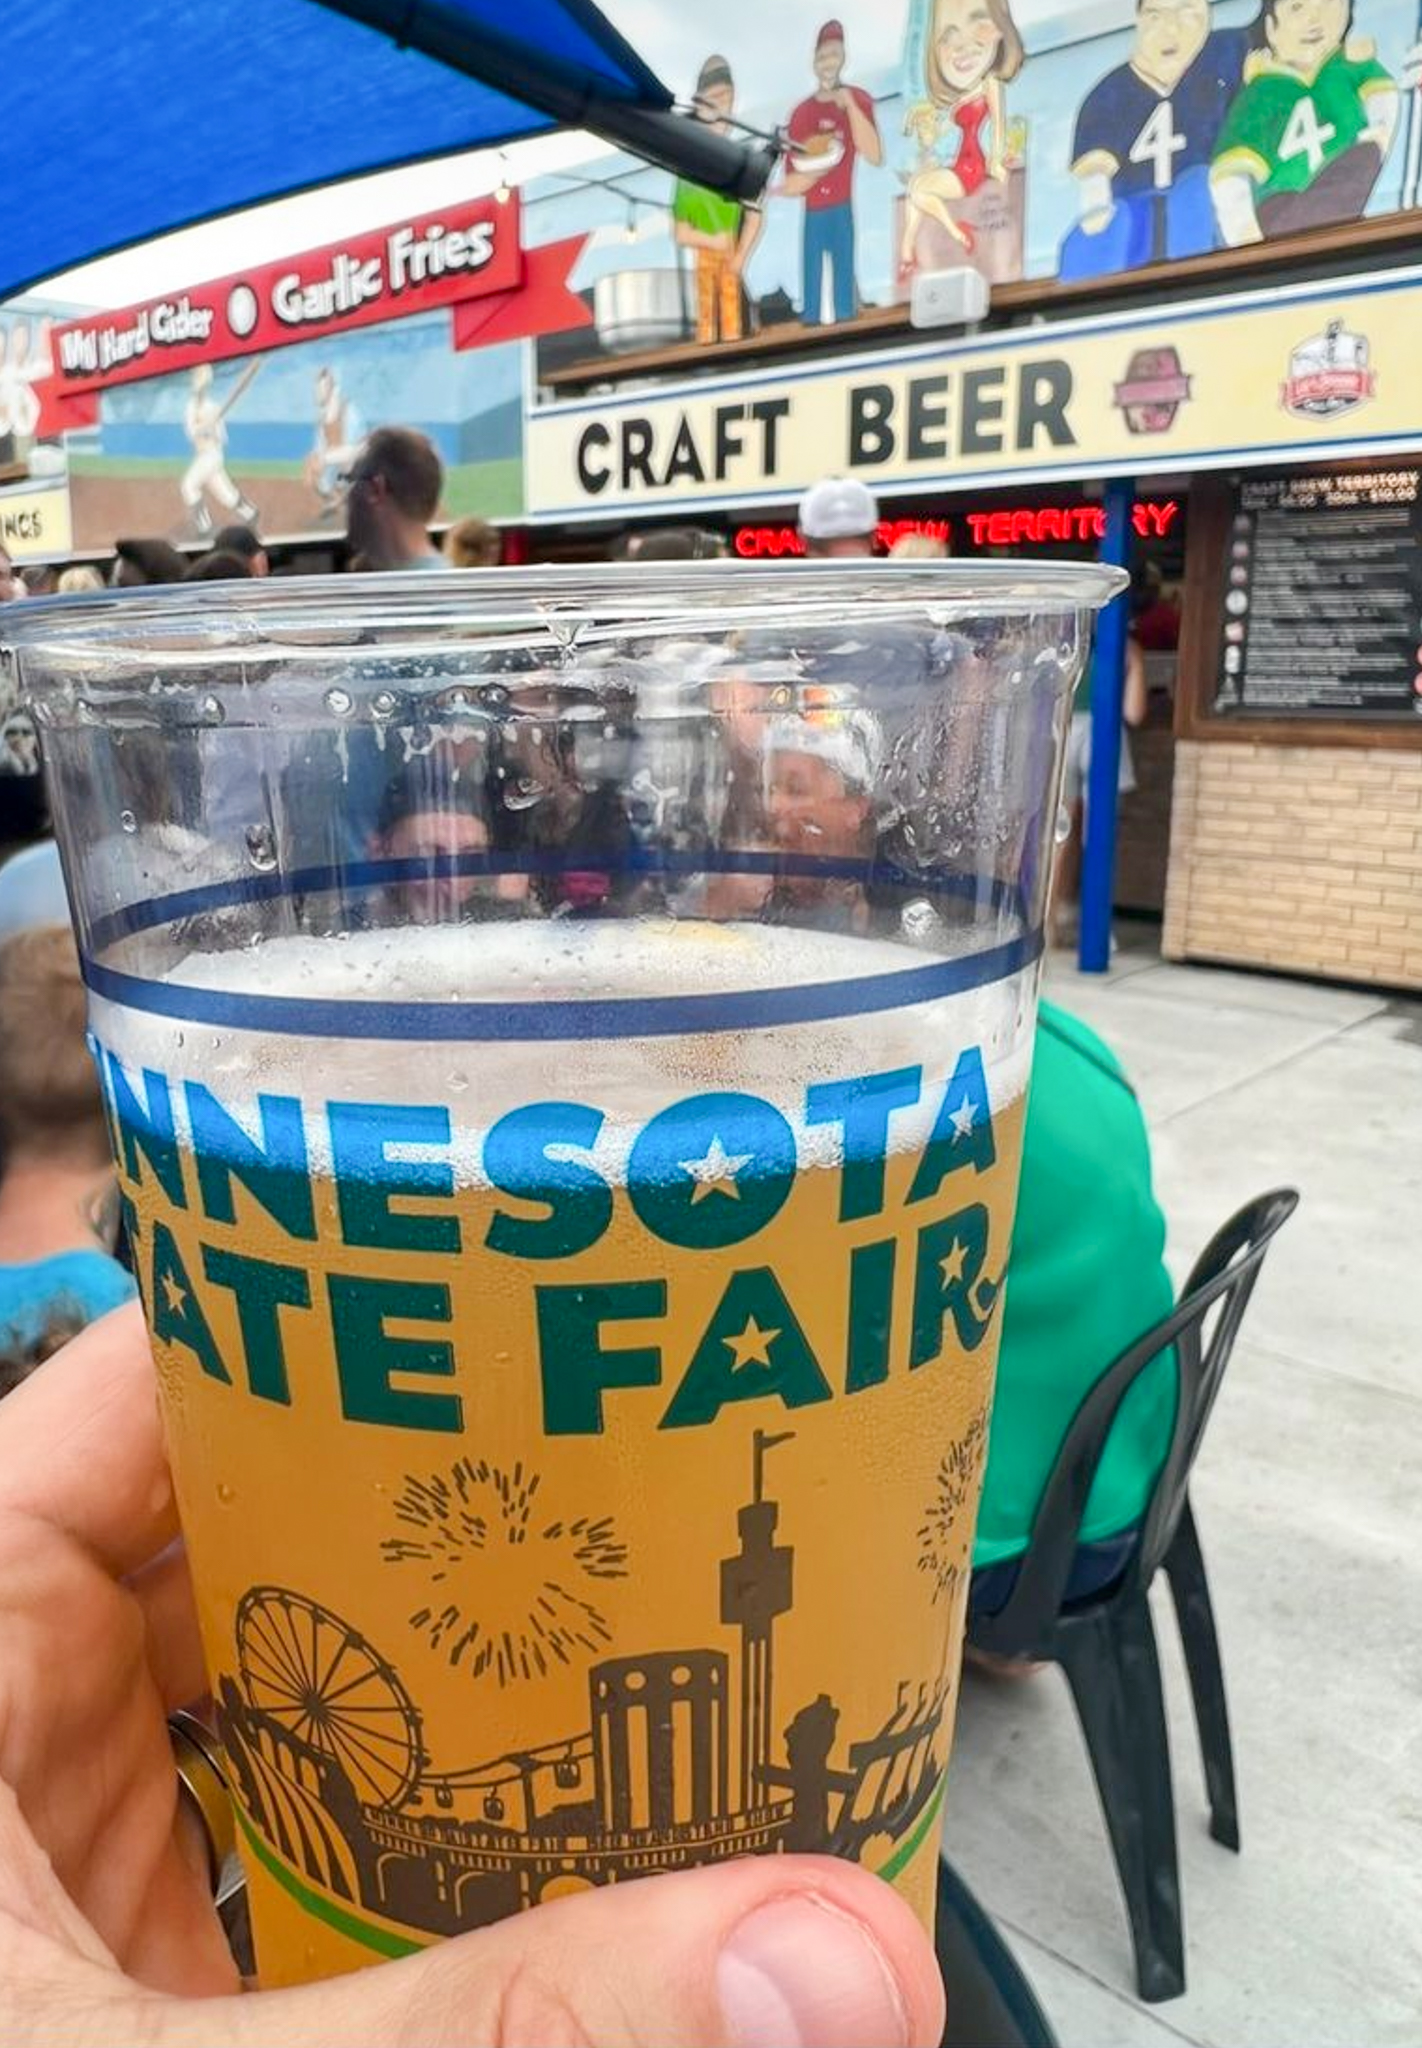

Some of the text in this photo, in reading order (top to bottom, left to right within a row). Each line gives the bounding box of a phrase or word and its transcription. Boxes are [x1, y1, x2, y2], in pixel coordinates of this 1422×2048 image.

[1129, 100, 1187, 189] 4
[1277, 96, 1337, 174] 4
[101, 310, 149, 370] Hard
[151, 297, 213, 343] Cider
[272, 254, 383, 323] Garlic
[388, 222, 495, 290] Fries
[577, 359, 1077, 494] CRAFT BEER
[736, 526, 808, 557] CRA
[535, 1202, 1008, 1437] FAIR
